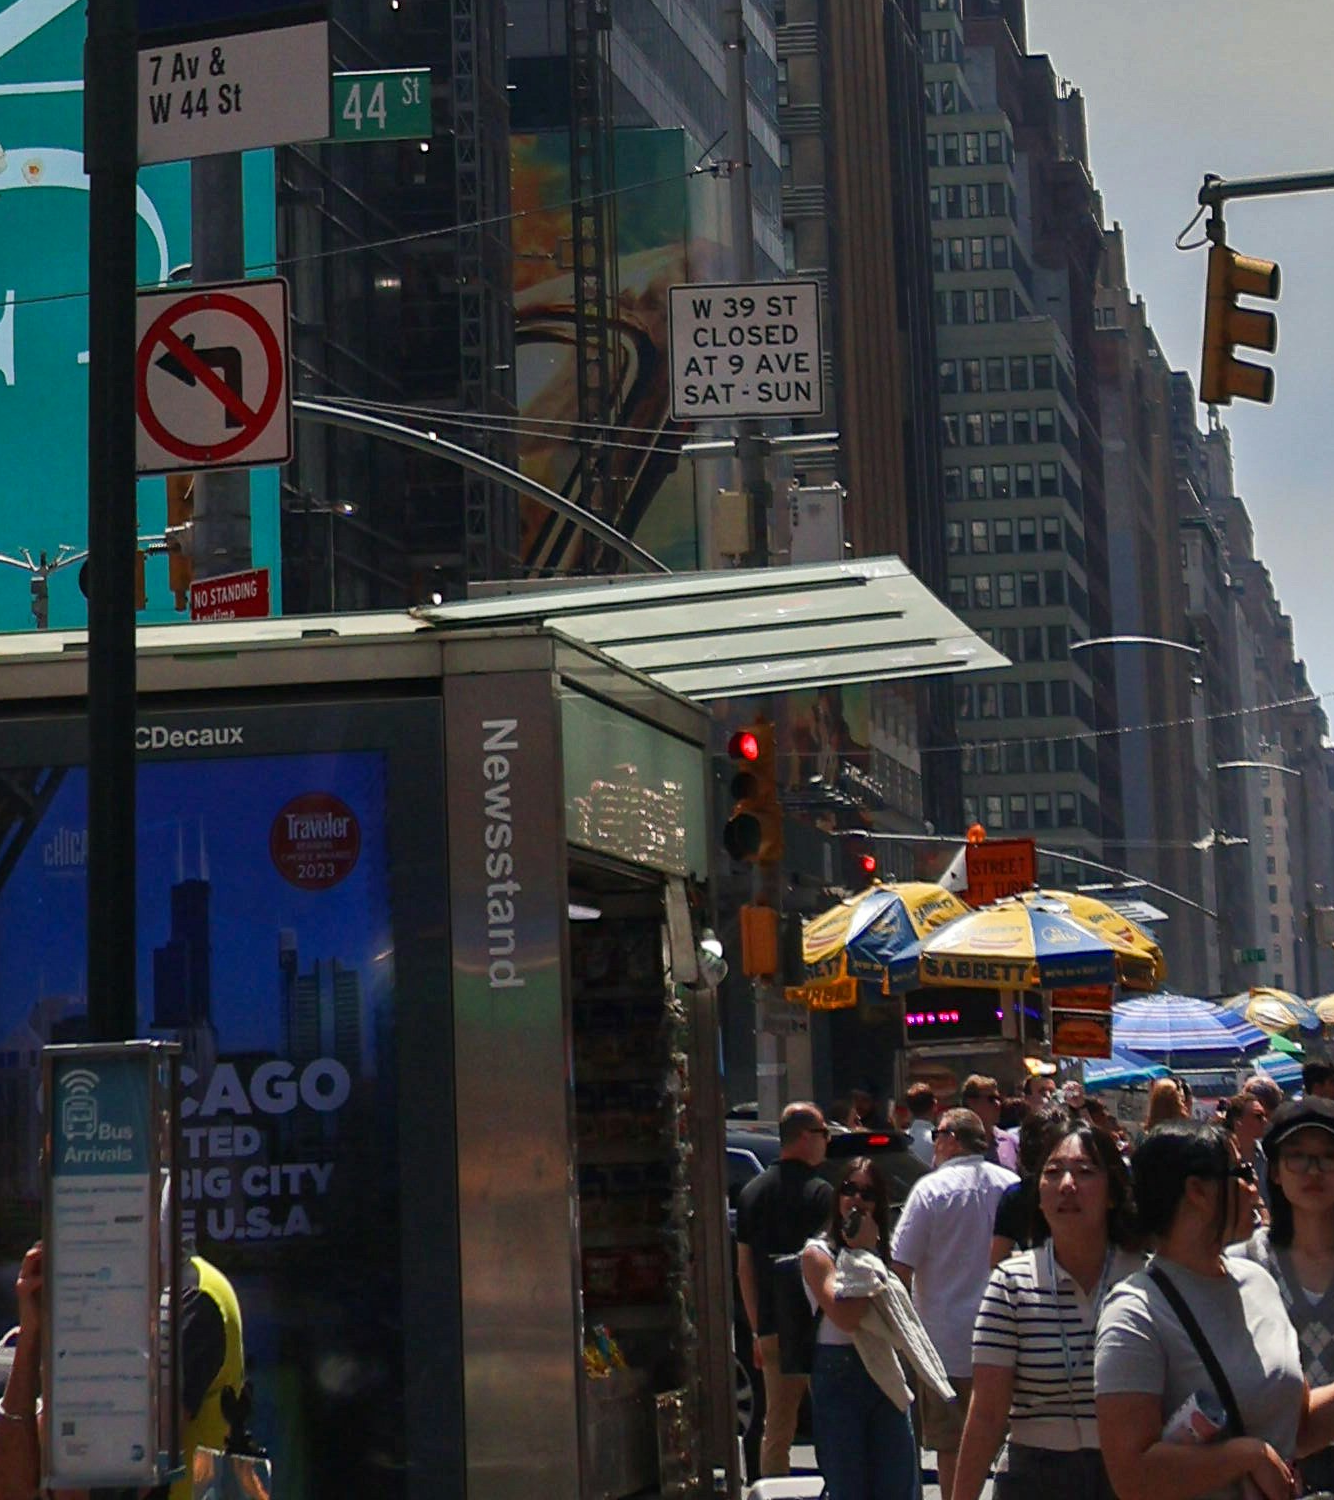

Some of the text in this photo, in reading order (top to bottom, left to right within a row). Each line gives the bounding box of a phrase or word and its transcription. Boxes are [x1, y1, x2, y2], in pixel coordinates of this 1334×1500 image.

[149, 47, 225, 87] 7 Av &
[149, 86, 242, 125] W 44 St
[342, 75, 422, 131] 44 St
[691, 294, 796, 319] W 39 ST
[693, 325, 798, 348] CLOSED
[684, 350, 811, 377] AT 9 AVE
[194, 580, 258, 609] NO STANDING
[285, 812, 350, 841] Traveler
[481, 717, 525, 991] Newsstand
[297, 861, 336, 880] 2023
[924, 959, 1029, 984] SABRETT
[99, 1124, 133, 1141] Bus
[64, 1144, 133, 1163] Arrivals
[243, 1161, 333, 1198] CITY
